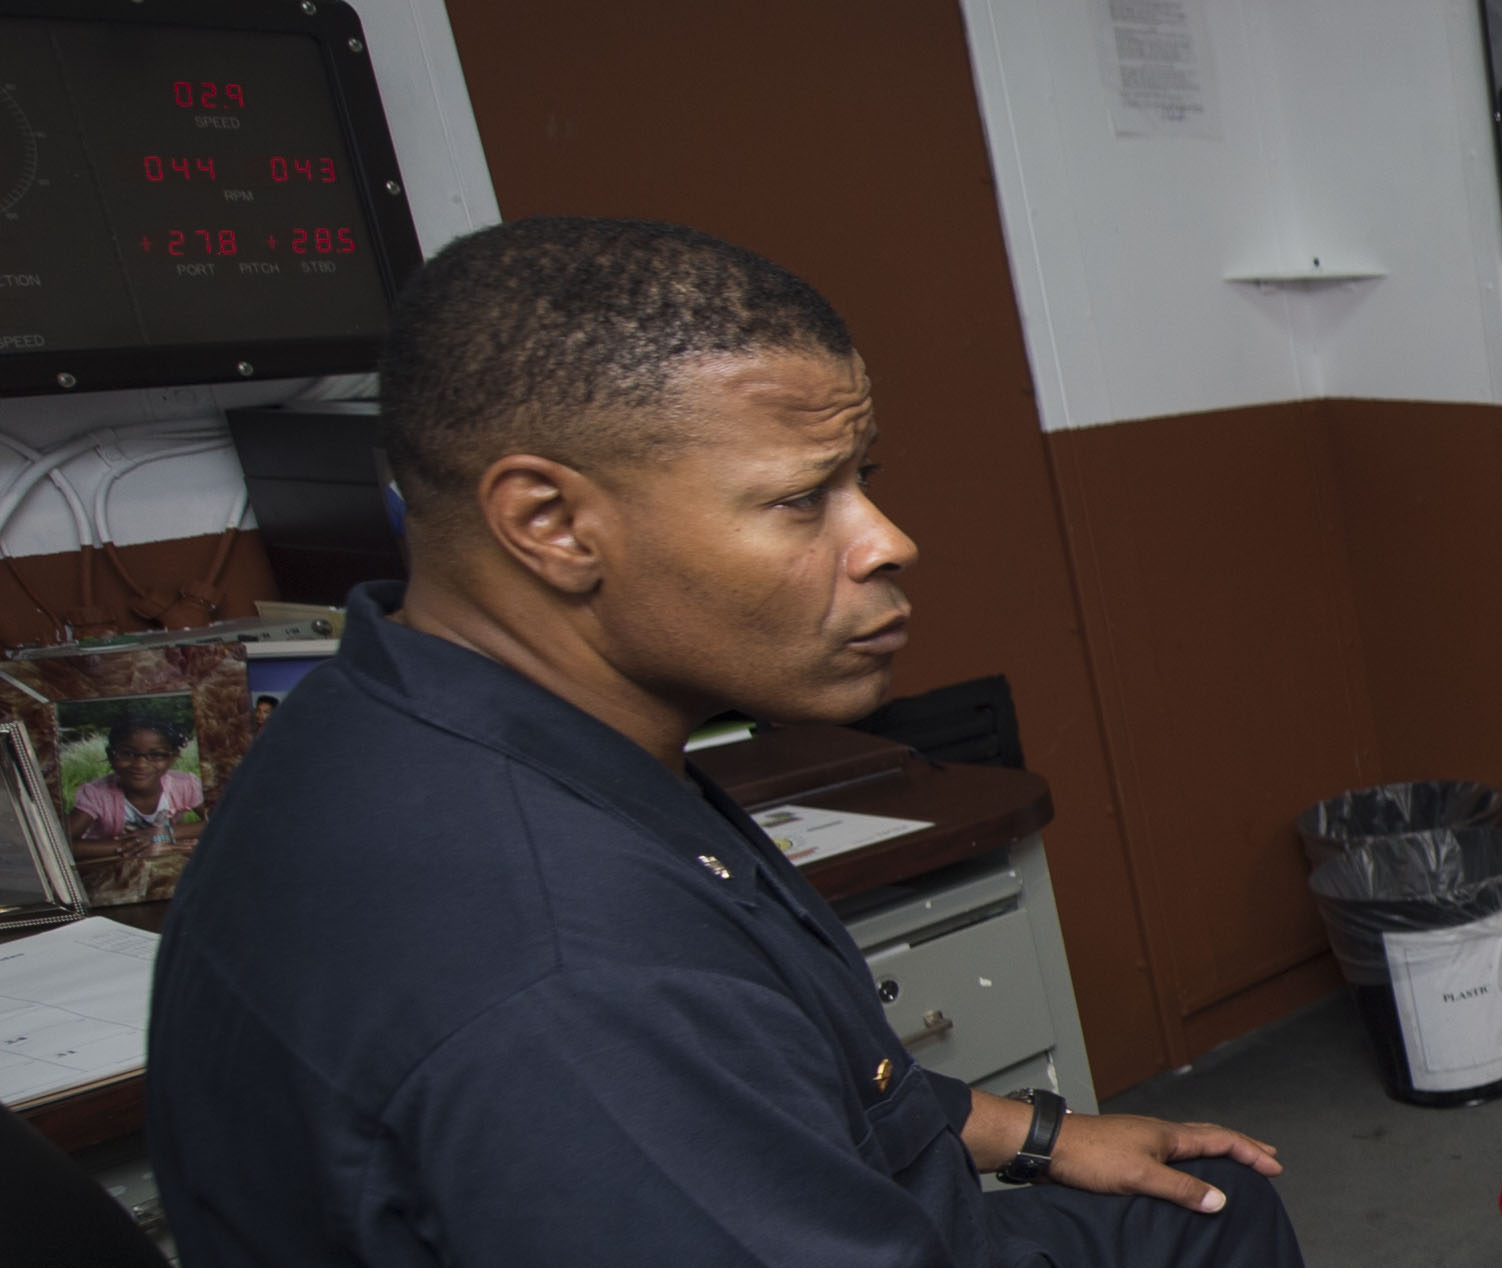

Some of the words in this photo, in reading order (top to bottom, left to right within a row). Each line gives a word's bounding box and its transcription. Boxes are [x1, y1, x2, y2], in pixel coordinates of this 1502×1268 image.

[194, 116, 240, 129] SPEED
[143, 156, 216, 182] 044
[269, 156, 336, 183] 043
[224, 189, 255, 203] RPM
[177, 263, 216, 278] PORT
[239, 262, 280, 276] PITCH
[302, 262, 336, 275] STBD
